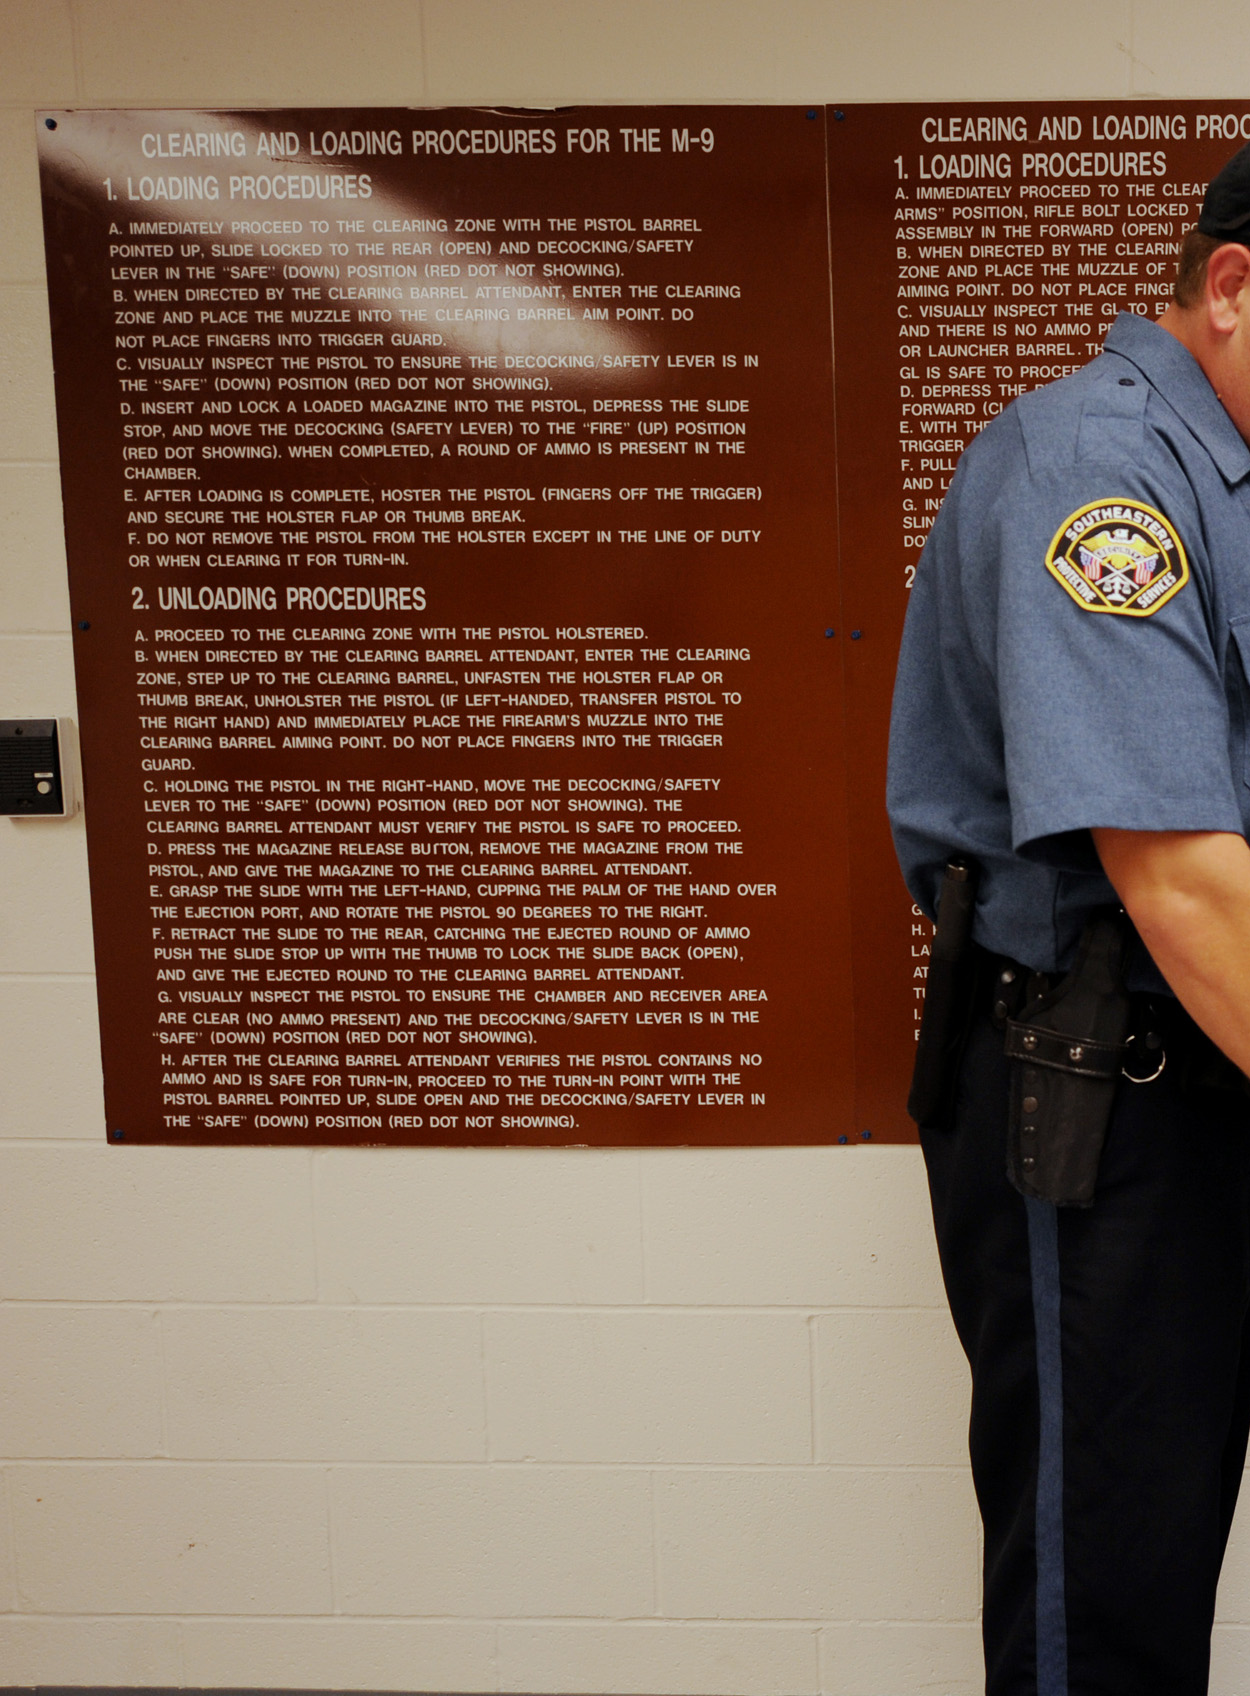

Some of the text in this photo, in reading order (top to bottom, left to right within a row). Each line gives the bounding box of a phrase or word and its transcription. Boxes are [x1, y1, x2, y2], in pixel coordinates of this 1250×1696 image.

[921, 114, 1187, 143] CLEARING AND LOADING
[141, 127, 715, 158] CLEARING AND LOADING PROCEDURES FOR THE M-9
[893, 151, 1167, 180] 1. LOADING PROCEDURES
[102, 174, 373, 202] 1. LOADING PROCEDURES
[894, 183, 1156, 200] A. IMMEDIATELY PROCEED TO THE
[108, 218, 703, 236] A. IMMEDIATELY PROCEED TO THE CLEARING ZONE WITH THE PISTOL BARREL
[898, 262, 1168, 279] ZONE AND PLACE THE MUZZLE OF
[123, 466, 201, 481] CHAMBER.
[127, 509, 526, 524] AND SECURE THE HOLSTER FLAP OR THUMB BREAK.
[1064, 505, 1175, 552] SOUTHEASTERN
[1052, 556, 1098, 604] PROTECTIVE
[1136, 571, 1178, 609] SERVICES
[131, 586, 427, 611] 2. UNLOADING PROCEDURES
[134, 626, 649, 642] A. PROCEED TO THE CLEARING ZONE WITH THE PISTOL HOLSTERED.
[141, 757, 196, 772] GUARD.
[162, 1114, 580, 1129] THE "SAFE" (DOWN) POSITION (RED DOT NOT SHOWING).
